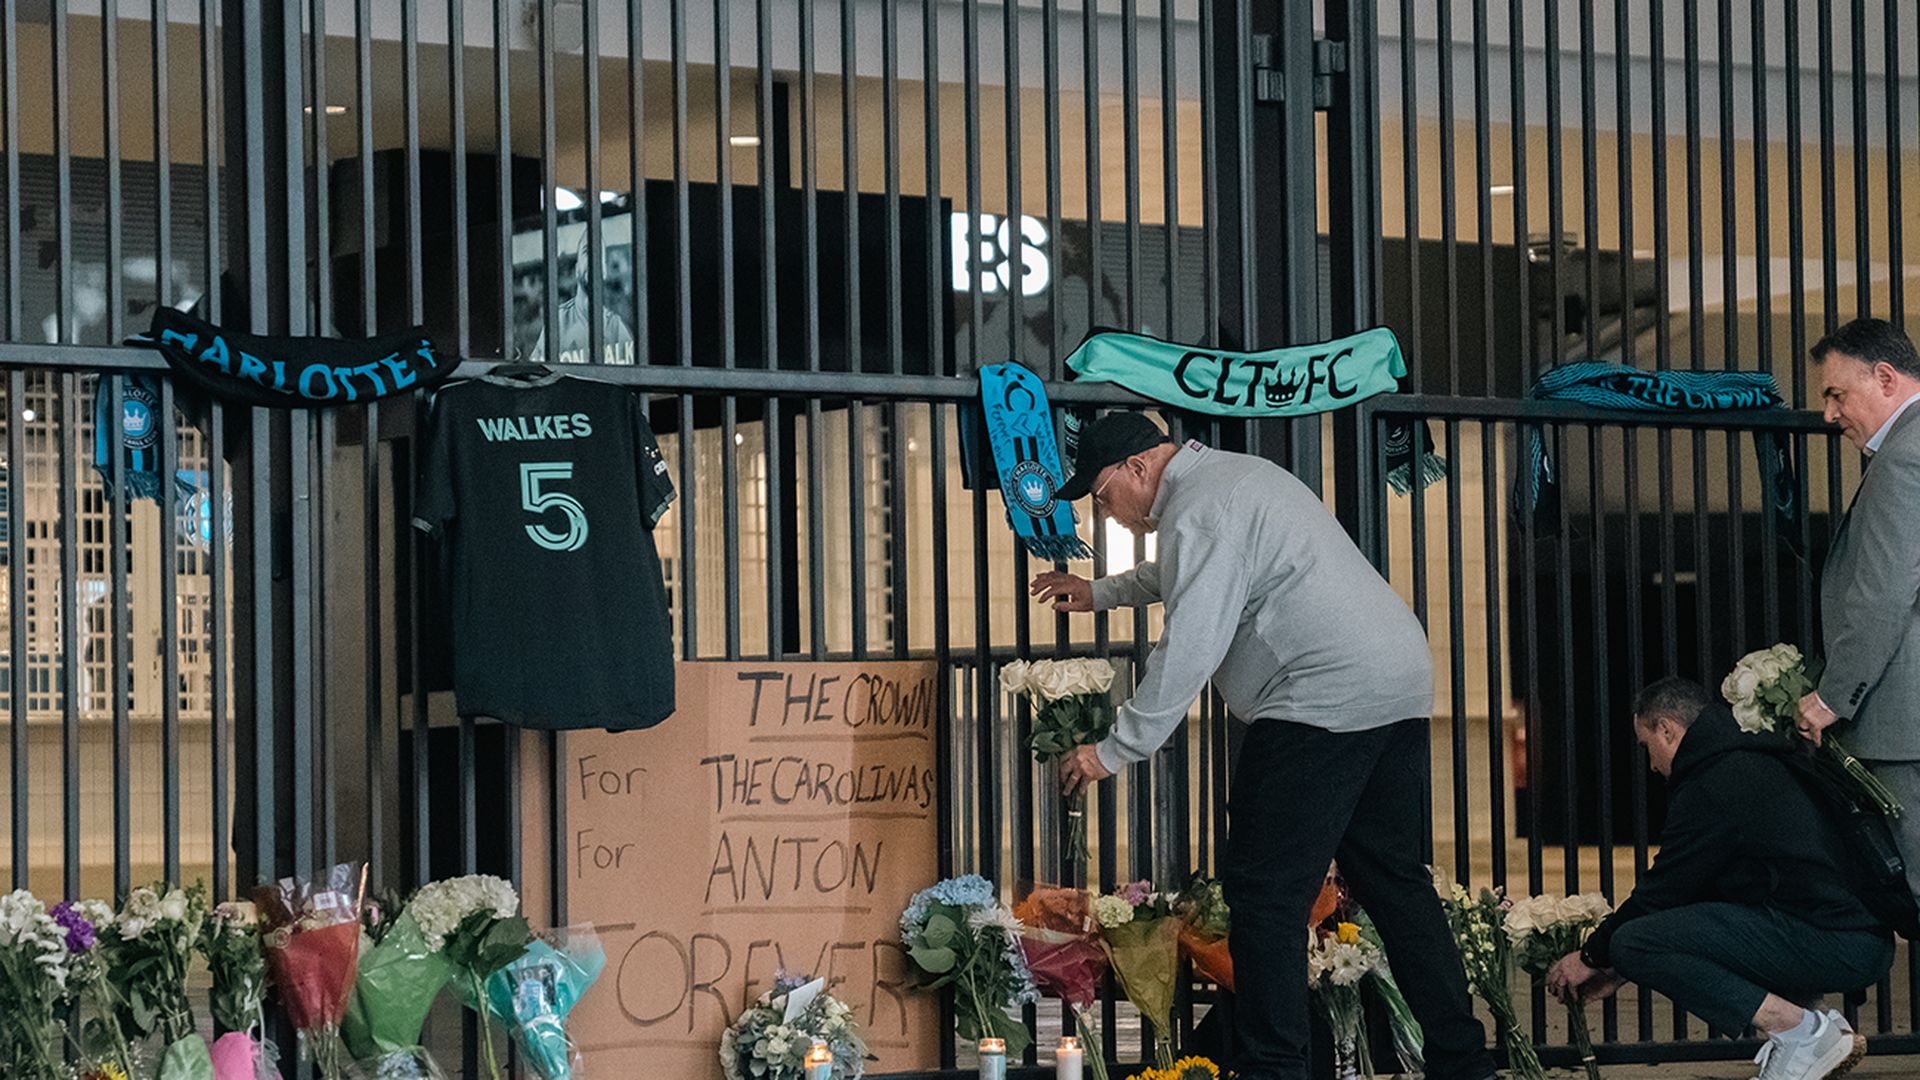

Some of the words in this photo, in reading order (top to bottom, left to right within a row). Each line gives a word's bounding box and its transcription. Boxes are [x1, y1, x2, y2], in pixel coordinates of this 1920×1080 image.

[1173, 350, 1280, 409] CLT
[1299, 348, 1359, 405] FC
[1627, 376, 1681, 407] THE
[476, 412, 593, 442] WALKES
[519, 461, 590, 552] 5
[737, 671, 841, 727] THE
[843, 672, 934, 729] CROWN
[579, 754, 648, 801] For
[700, 753, 773, 814] THE
[771, 756, 934, 809] CAROLINAS
[576, 828, 636, 880] For
[704, 830, 883, 904] ANTON
